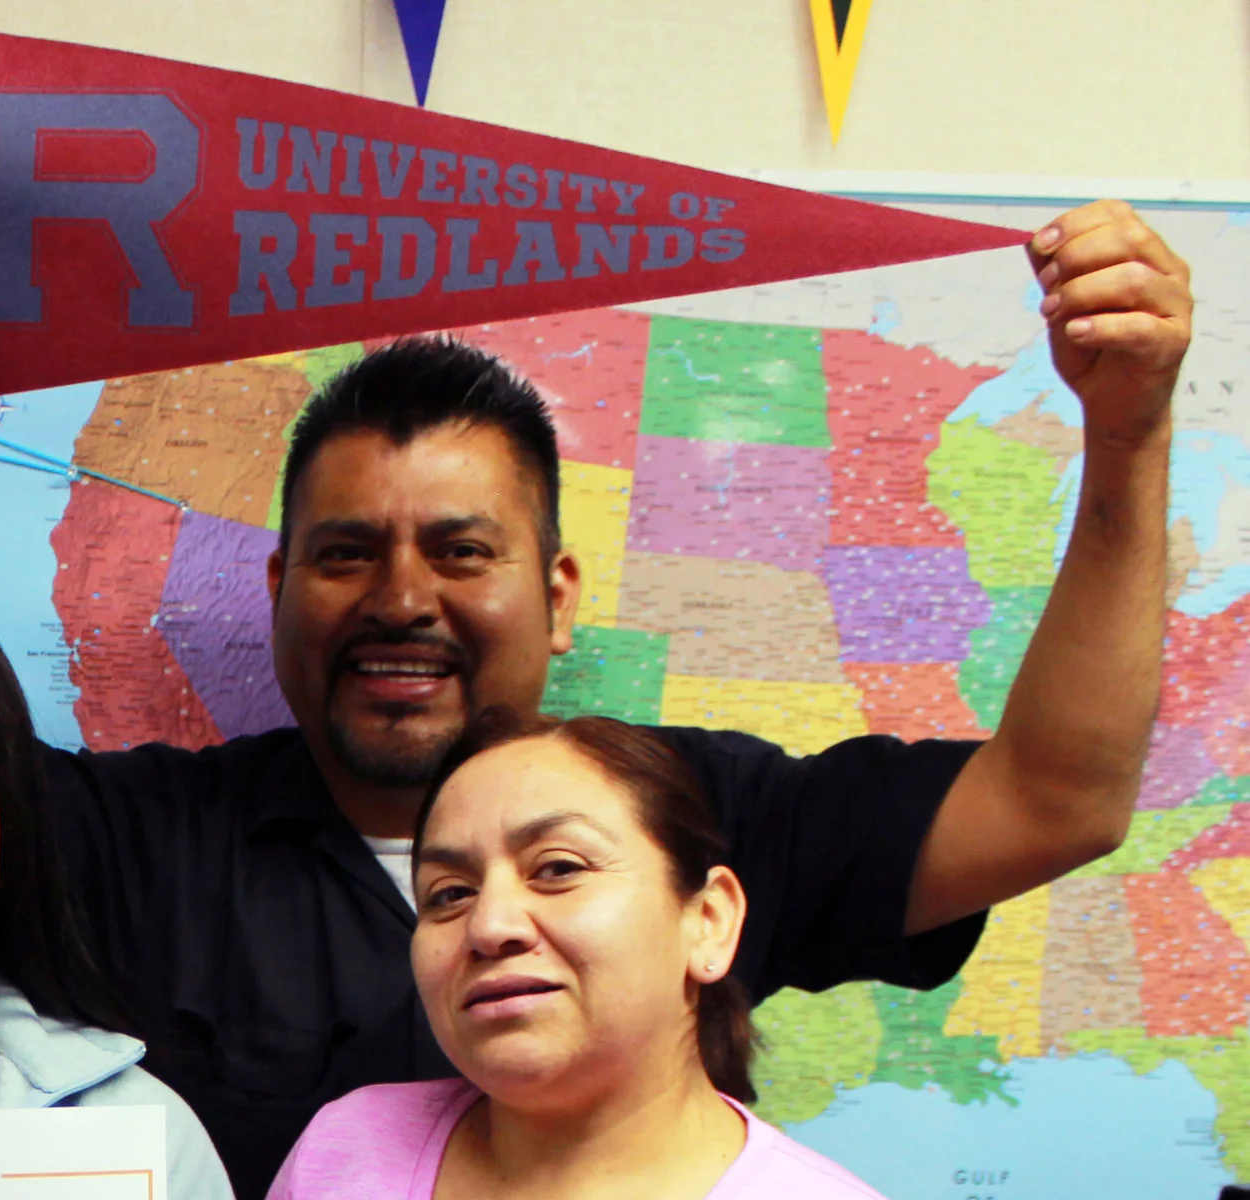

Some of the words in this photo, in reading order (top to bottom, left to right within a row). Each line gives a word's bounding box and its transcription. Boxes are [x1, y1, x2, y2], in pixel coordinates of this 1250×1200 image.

[235, 118, 646, 216] UNIVERSITY
[668, 194, 735, 224] OF
[228, 210, 747, 317] REDLANDS
[953, 1169, 1011, 1185] GULF
